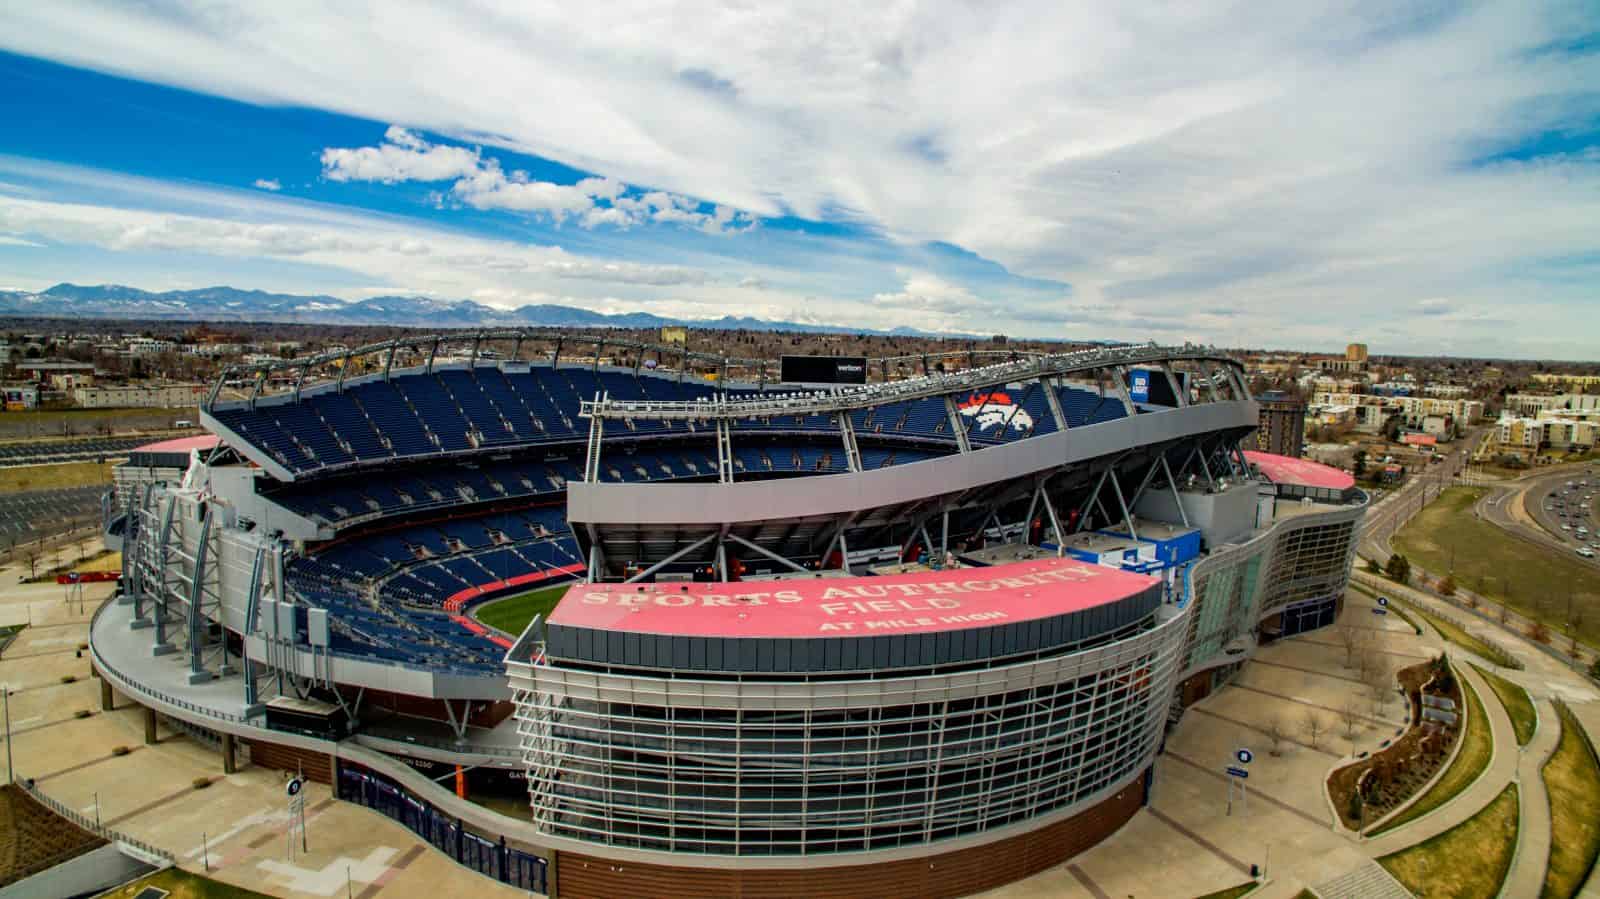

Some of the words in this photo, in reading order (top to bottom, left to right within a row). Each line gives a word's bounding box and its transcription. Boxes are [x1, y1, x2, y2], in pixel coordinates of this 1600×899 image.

[582, 590, 804, 607] SPORTS
[820, 566, 1101, 600] AUTHORITY
[819, 598, 962, 616] FIELD
[819, 621, 854, 632] AT
[865, 617, 933, 630] MILE
[939, 610, 1009, 624] HIGH
